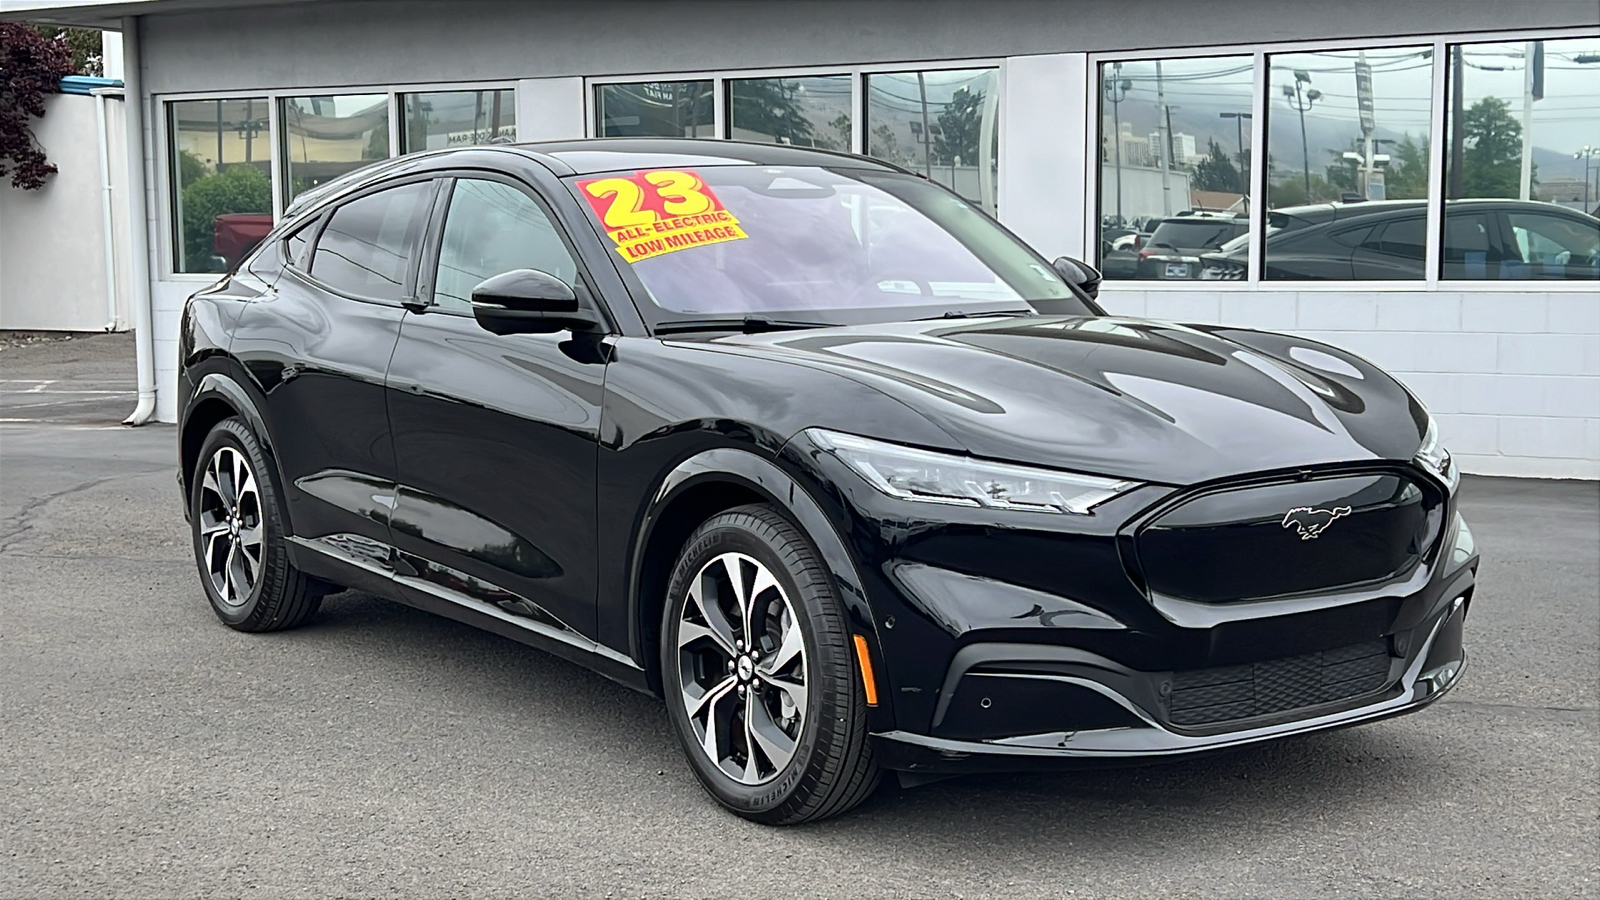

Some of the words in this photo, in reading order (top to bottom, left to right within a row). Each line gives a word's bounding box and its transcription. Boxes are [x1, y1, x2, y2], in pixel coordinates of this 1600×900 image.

[586, 171, 715, 228] 23
[617, 212, 731, 243] ALL-ELECTRIC
[626, 239, 665, 259] LOW
[667, 226, 737, 249] MILEAGE
[678, 533, 720, 578] MICHELIN
